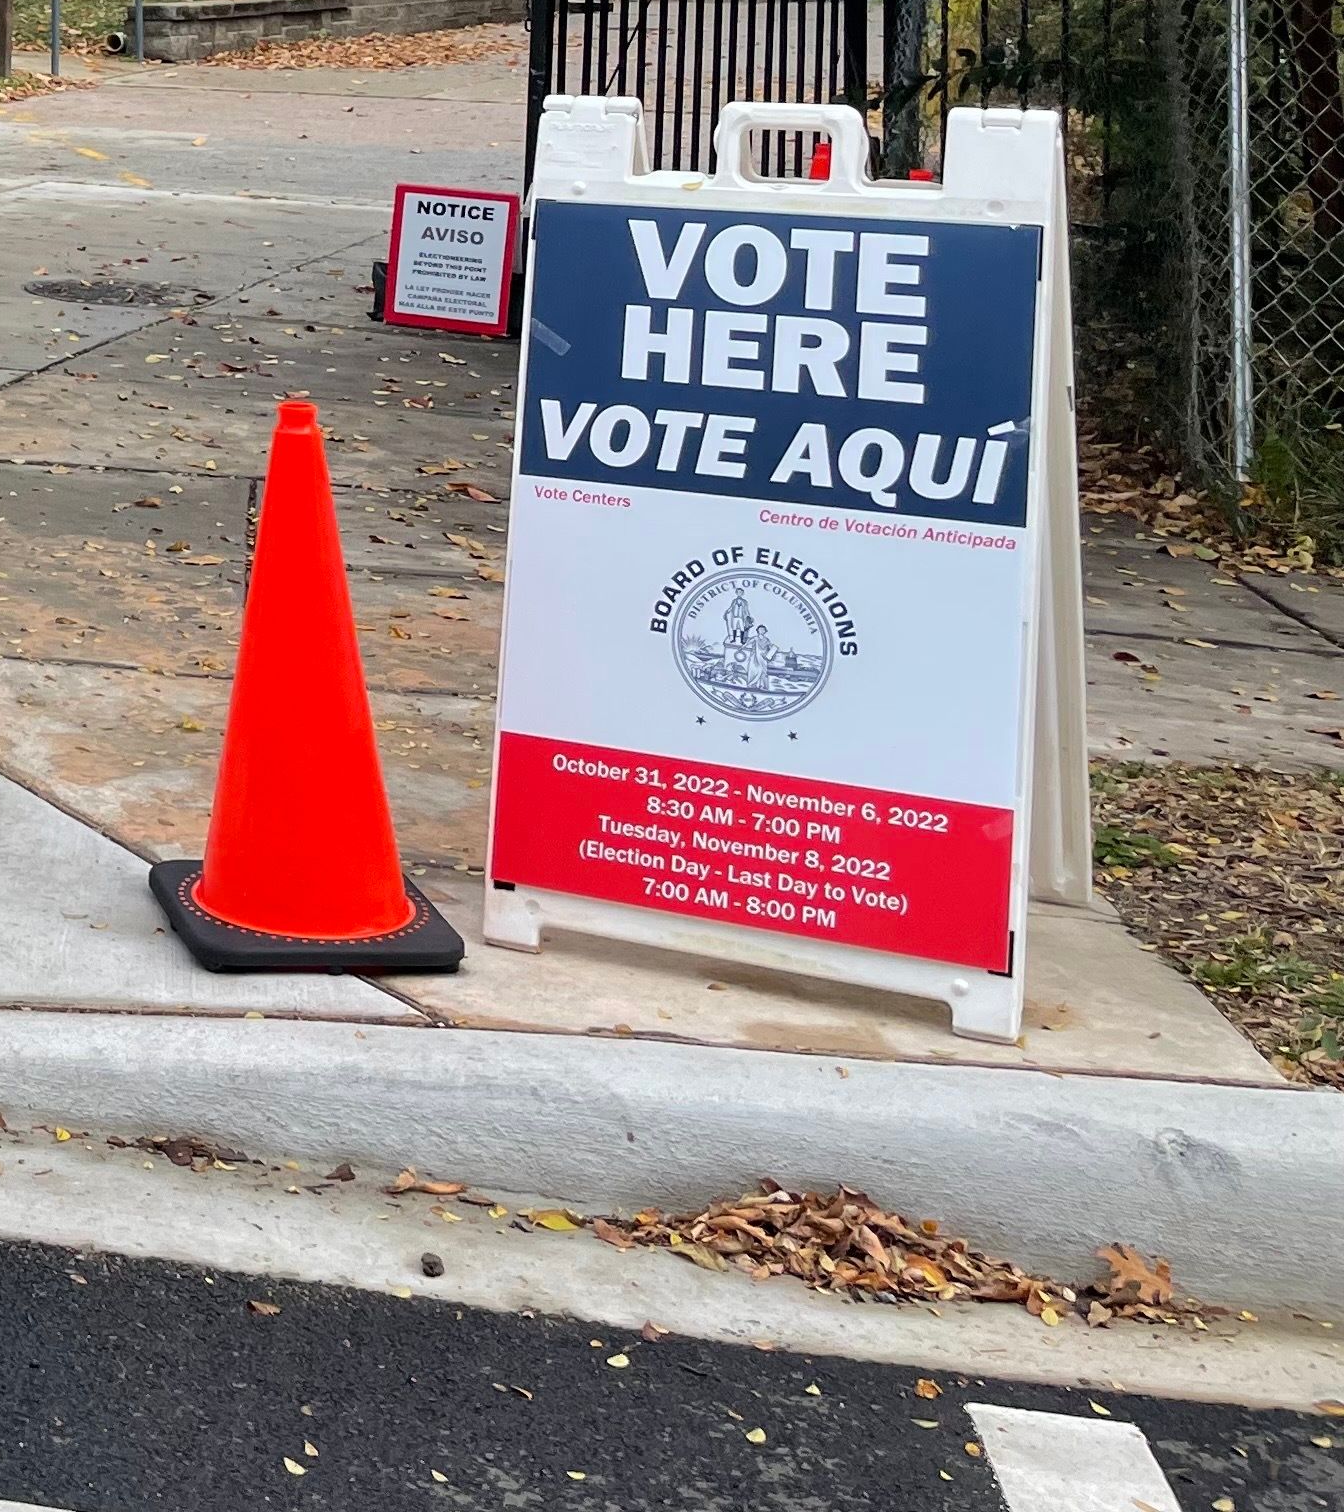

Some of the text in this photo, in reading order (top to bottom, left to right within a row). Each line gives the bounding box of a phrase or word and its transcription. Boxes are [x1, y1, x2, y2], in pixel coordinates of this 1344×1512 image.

[417, 201, 494, 221] NOTICE
[421, 227, 484, 245] AVISO
[628, 219, 930, 318] VOTE
[622, 304, 927, 404] HERE
[540, 398, 1015, 508] VOTE AQUÍ
[535, 486, 1016, 551] Vote Centers Centro de Votación Anticipada
[650, 546, 858, 656] BOARD OF ELECTIONS
[688, 579, 817, 635] DISTRICT OF COLUMBIA
[553, 754, 949, 833] October 31, 2022 November 6, 2022
[646, 796, 841, 844] 8:30 AM 7:00 PM
[579, 838, 908, 916] (Election Day Last Day to Vote)
[598, 815, 891, 880] Tuesday, November 8, 2022
[643, 877, 836, 928] 7:00 AM 8:00 PM
